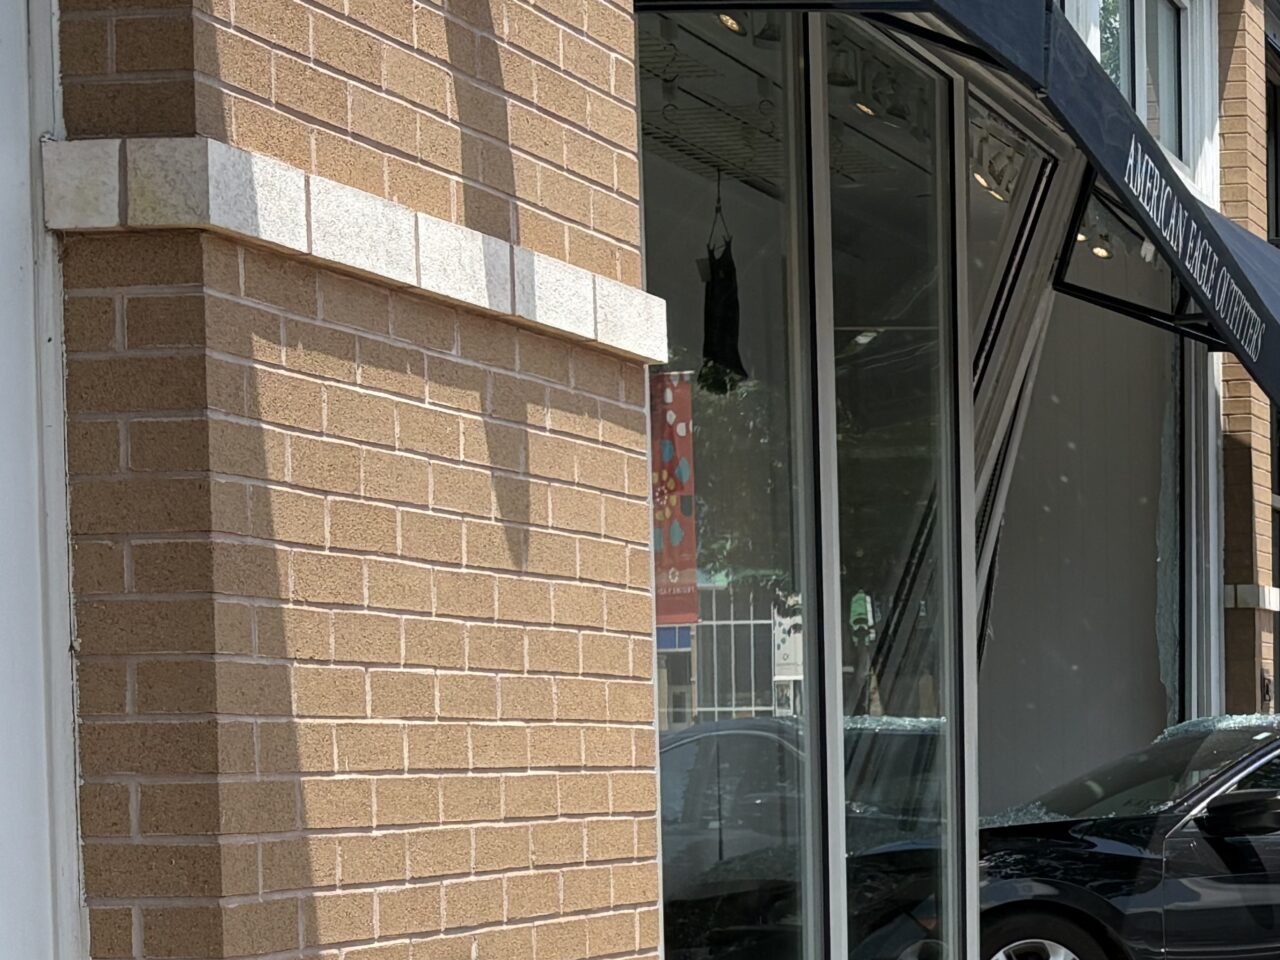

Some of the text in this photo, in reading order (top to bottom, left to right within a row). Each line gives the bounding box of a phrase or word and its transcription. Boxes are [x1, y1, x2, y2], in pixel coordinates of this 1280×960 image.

[1124, 133, 1266, 363] AMERICAN EAGLE OUTFITTERS
